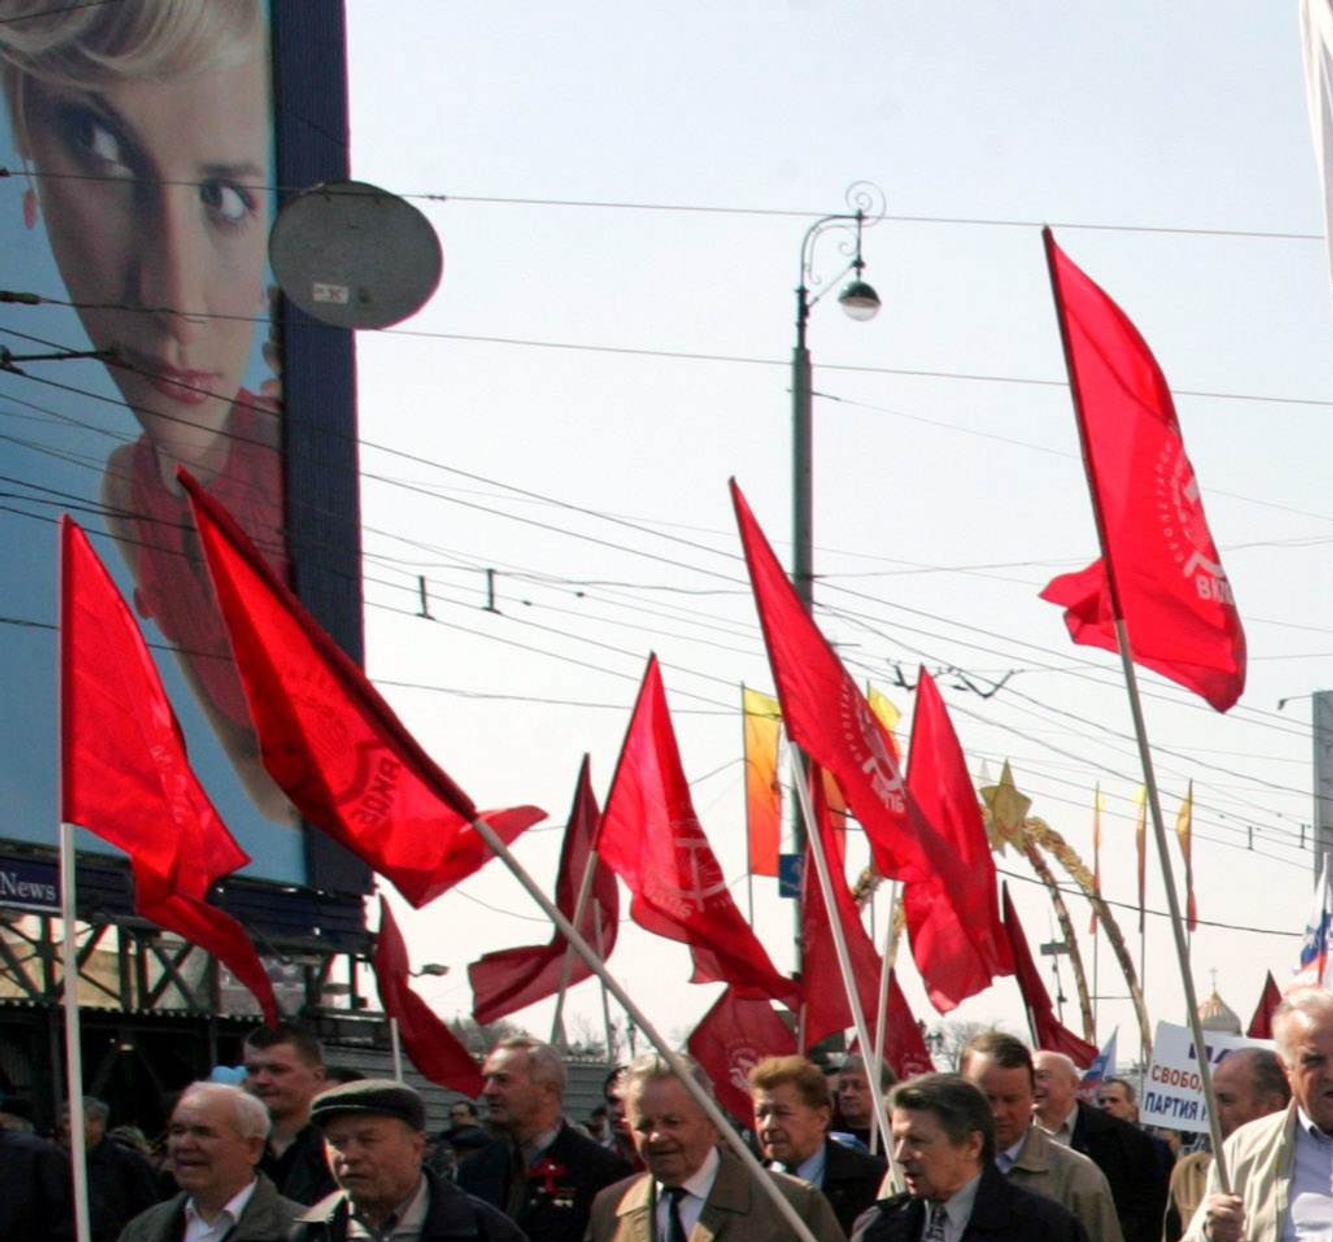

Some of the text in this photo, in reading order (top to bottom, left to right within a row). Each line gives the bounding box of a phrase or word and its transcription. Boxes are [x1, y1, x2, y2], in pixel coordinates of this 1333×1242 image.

[0, 870, 57, 901] News
[1152, 1065, 1201, 1092] СВОБО
[1144, 1091, 1198, 1121] ПАРТИЯ
